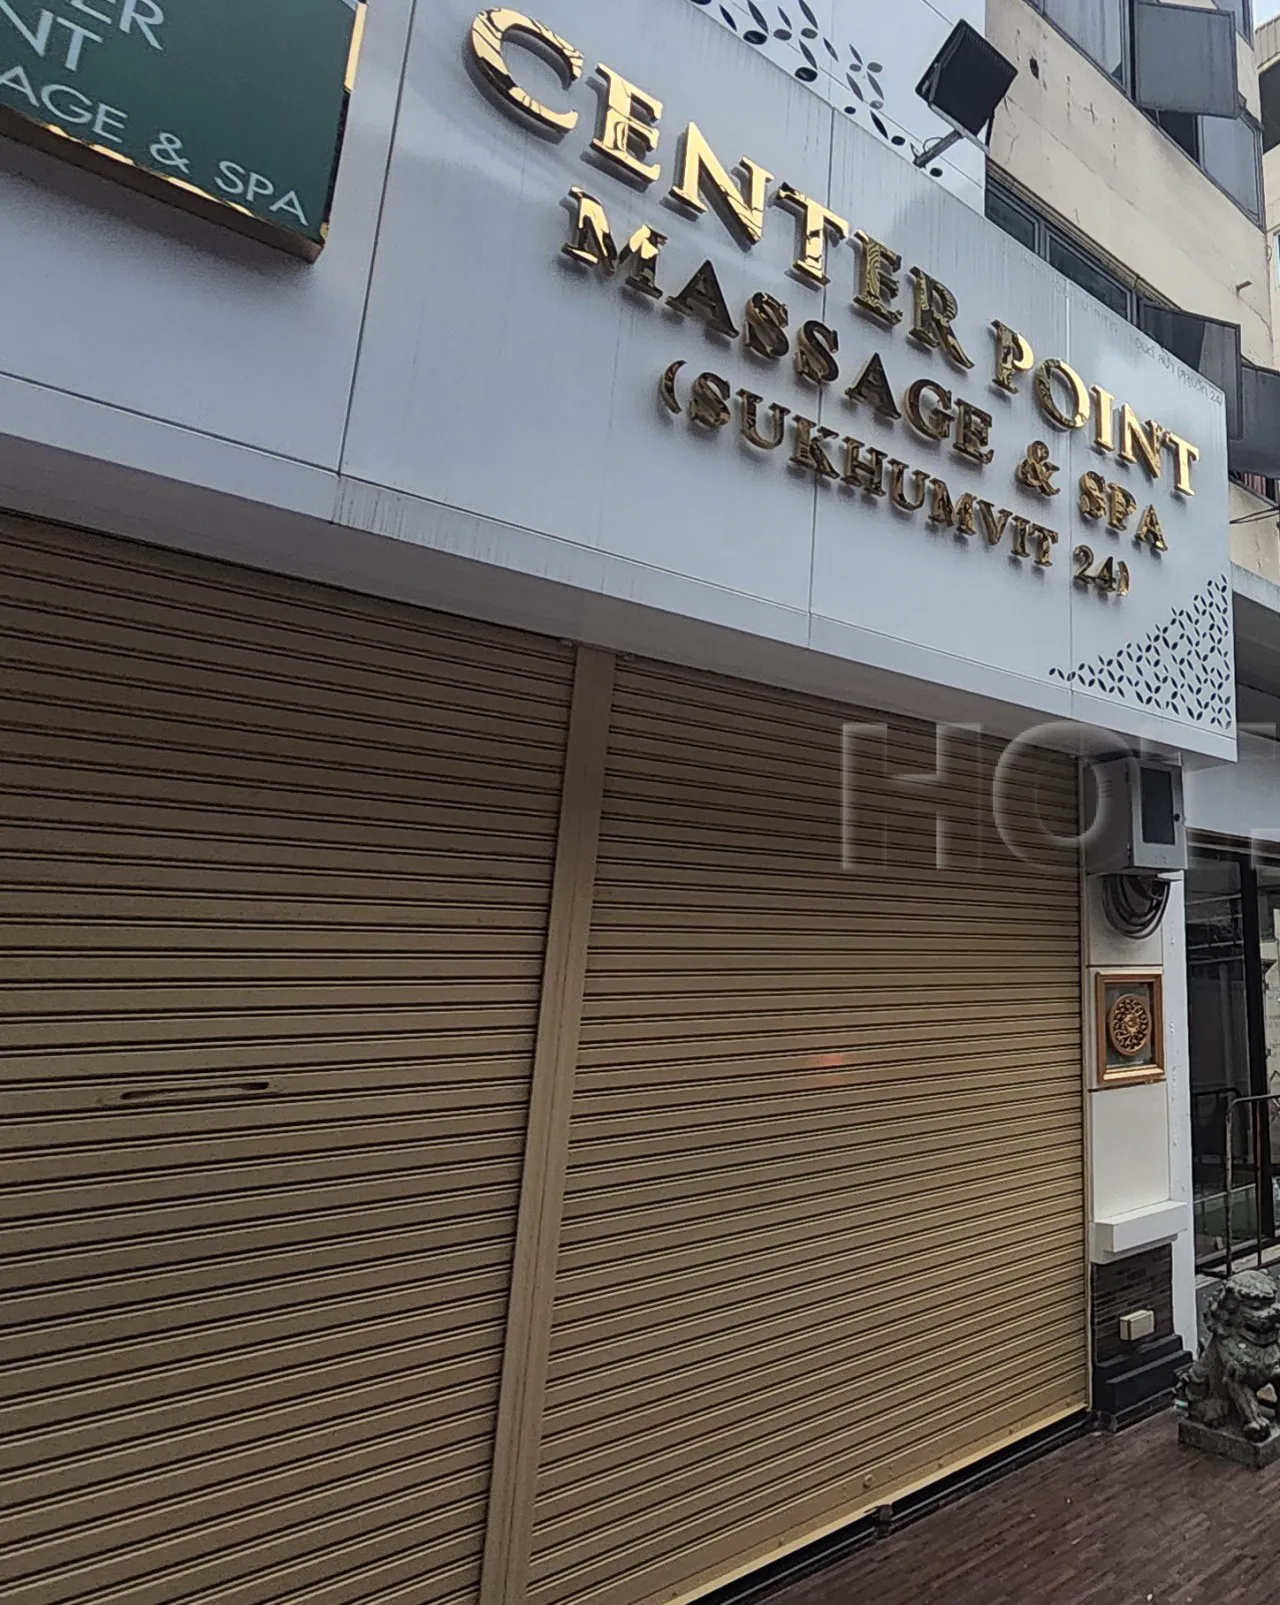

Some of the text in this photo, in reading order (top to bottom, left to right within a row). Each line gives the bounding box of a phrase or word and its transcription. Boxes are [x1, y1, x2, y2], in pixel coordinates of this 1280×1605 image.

[149, 132, 190, 174] &
[214, 160, 309, 226] SPA
[467, 6, 1200, 496] CENTER POINT
[562, 185, 994, 465] MASSAGE
[1017, 439, 1061, 497] &
[1080, 470, 1169, 552] SPA
[660, 359, 1131, 597] (SUKHUMVIT 24)
